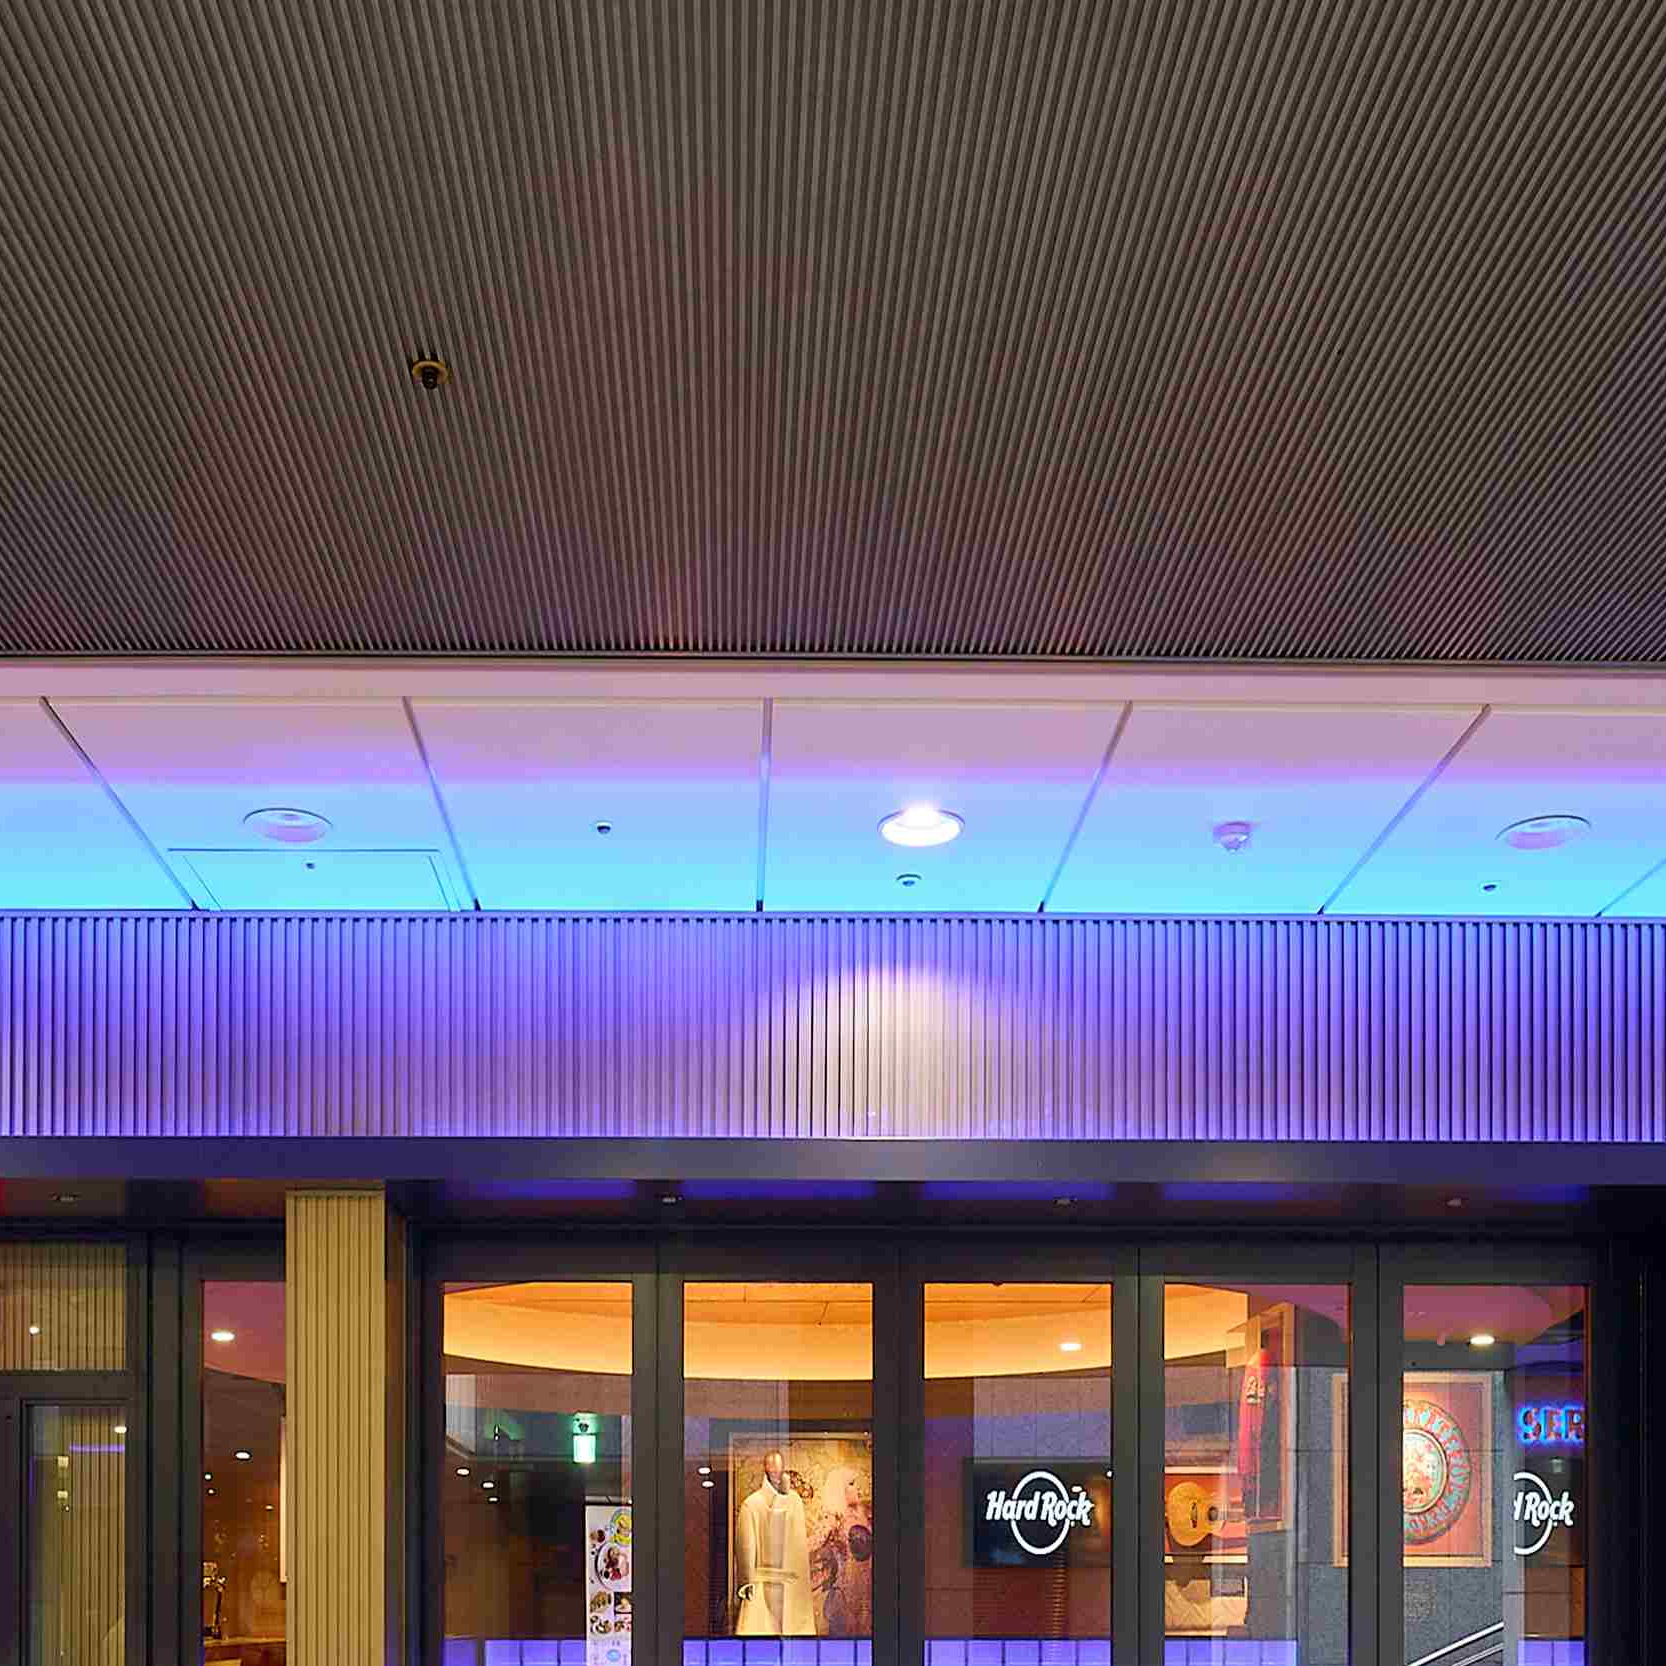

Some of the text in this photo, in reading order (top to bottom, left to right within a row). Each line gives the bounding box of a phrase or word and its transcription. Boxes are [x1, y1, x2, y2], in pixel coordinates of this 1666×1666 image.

[986, 1490, 1094, 1527] Hard Rock
[1523, 1491, 1574, 1527] Rock
